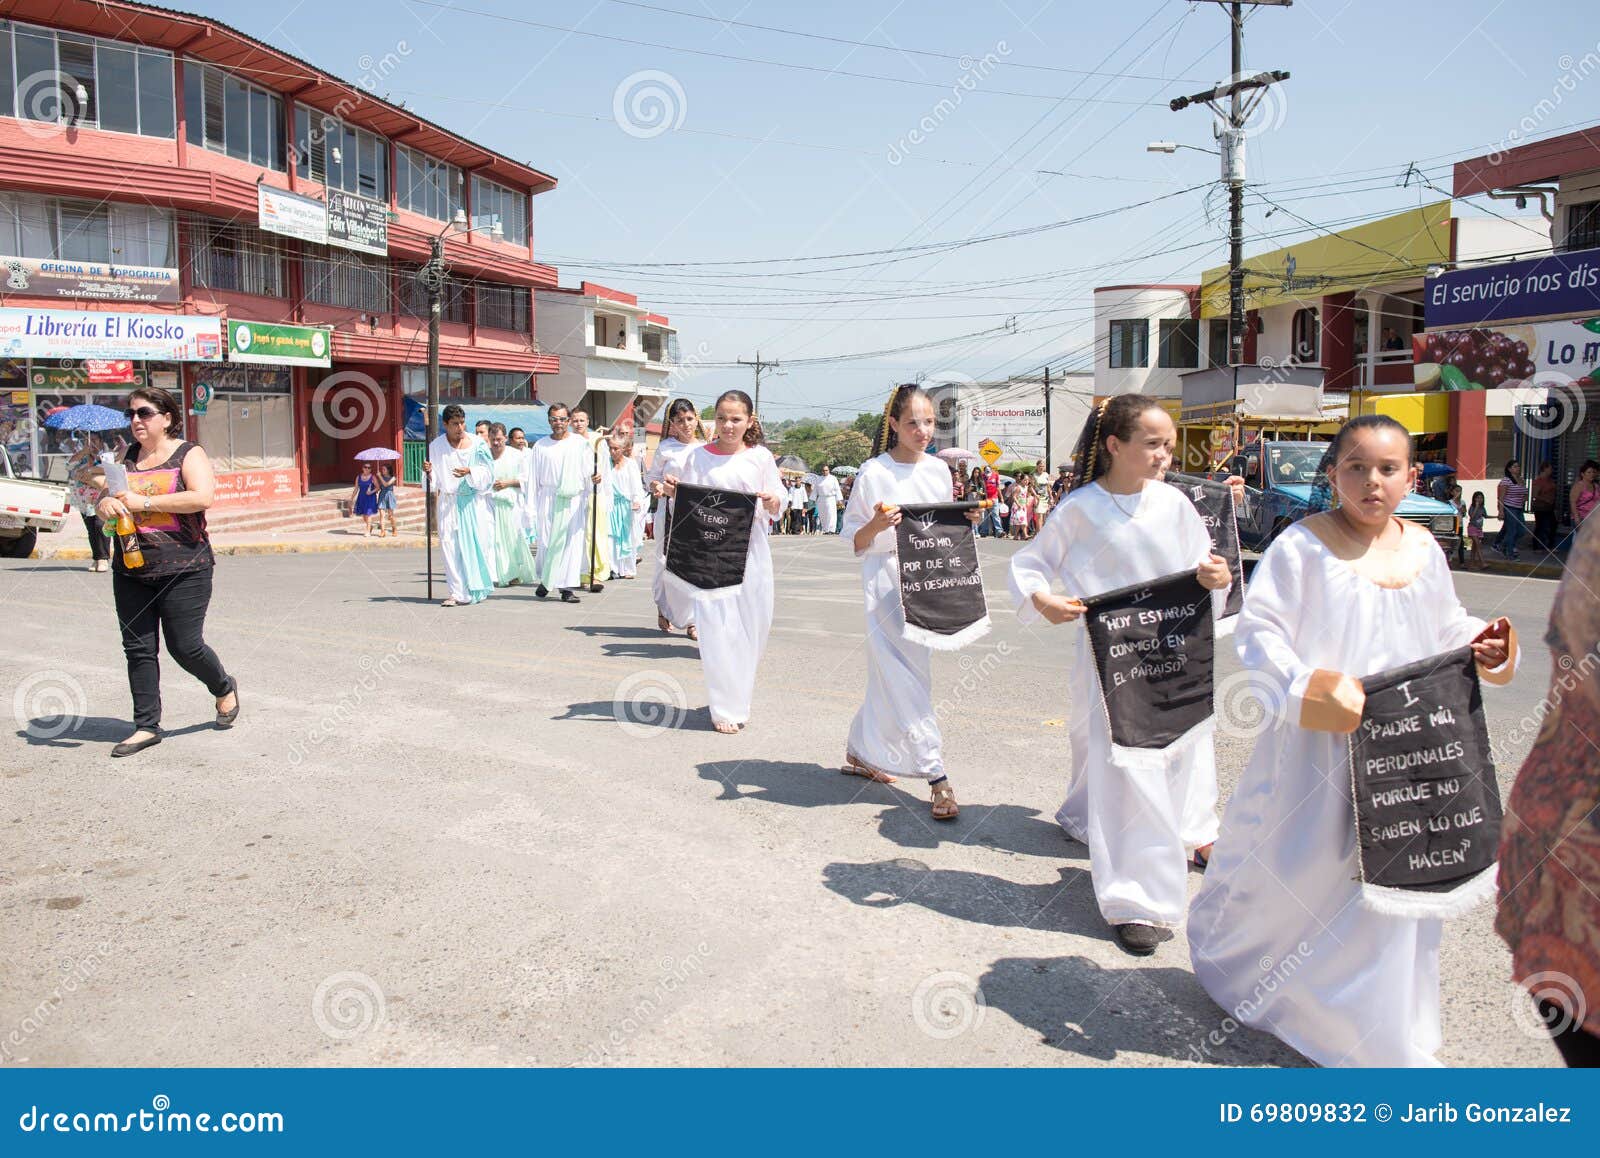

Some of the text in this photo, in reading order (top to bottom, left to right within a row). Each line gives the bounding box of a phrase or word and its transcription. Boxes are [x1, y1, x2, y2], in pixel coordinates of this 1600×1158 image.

[41, 263, 83, 274] OFICINA
[90, 267, 103, 275] DE
[1432, 284, 1447, 305] El
[1452, 274, 1521, 303] servicio
[1526, 273, 1562, 294] nos
[25, 315, 184, 340] Librería El Kiosko
[1547, 340, 1576, 365] Lo
[708, 492, 728, 507] V
[1191, 485, 1206, 502] III
[919, 510, 938, 531] IV
[903, 561, 921, 572] POR
[949, 556, 961, 567] ME
[902, 582, 921, 592] HAS
[1140, 603, 1196, 625] ESTARAS
[1109, 634, 1186, 659] CONMIGO EN
[1113, 671, 1127, 686] EL
[1397, 681, 1420, 708] I
[1366, 741, 1464, 776] PERDONALES
[1372, 778, 1460, 808] PORQUE NO
[1371, 806, 1483, 842] SABEN LO QUE
